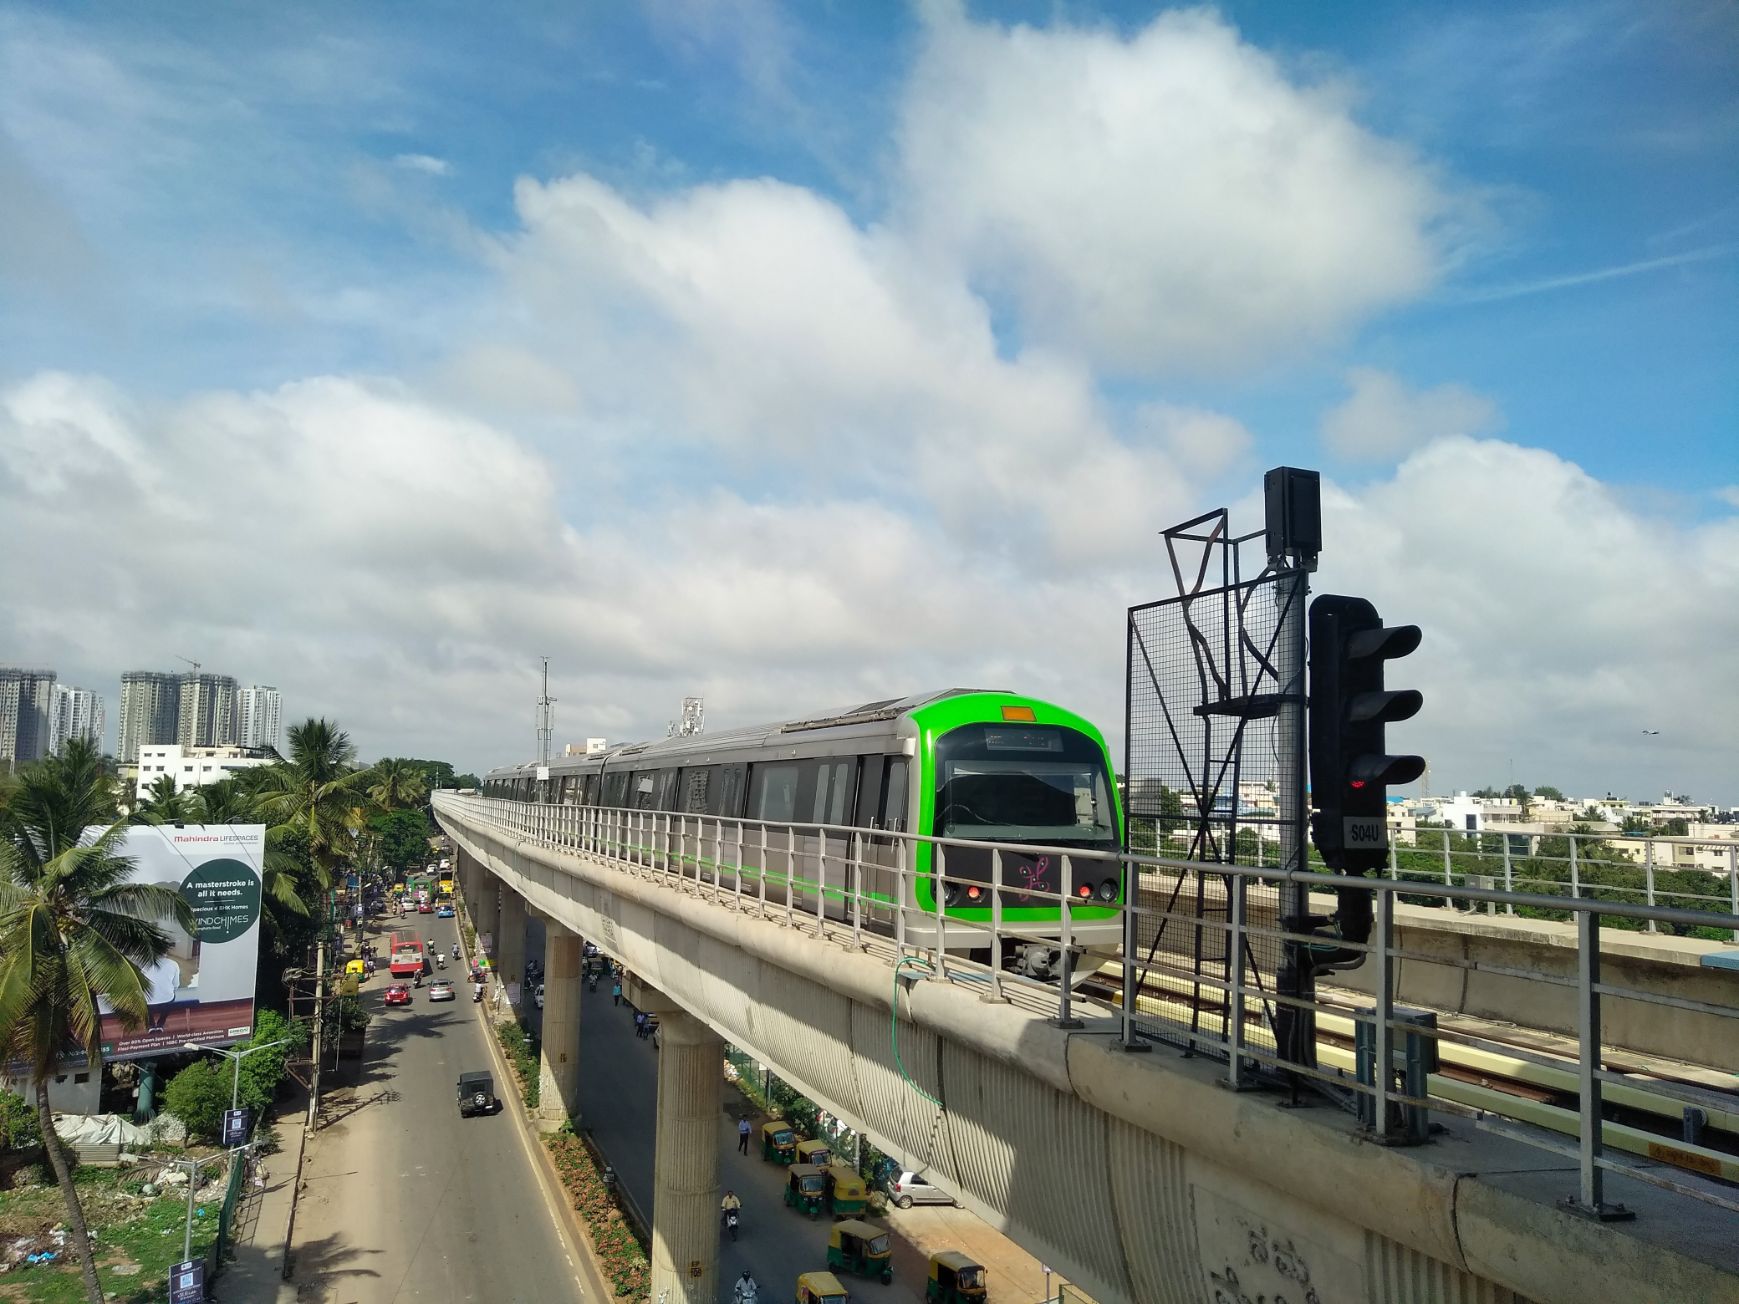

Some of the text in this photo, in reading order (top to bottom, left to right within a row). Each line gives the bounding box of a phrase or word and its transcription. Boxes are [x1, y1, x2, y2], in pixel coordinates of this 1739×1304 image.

[1351, 823, 1379, 842] S04U
[195, 880, 246, 888] masterstroke
[217, 889, 243, 897] needs.
